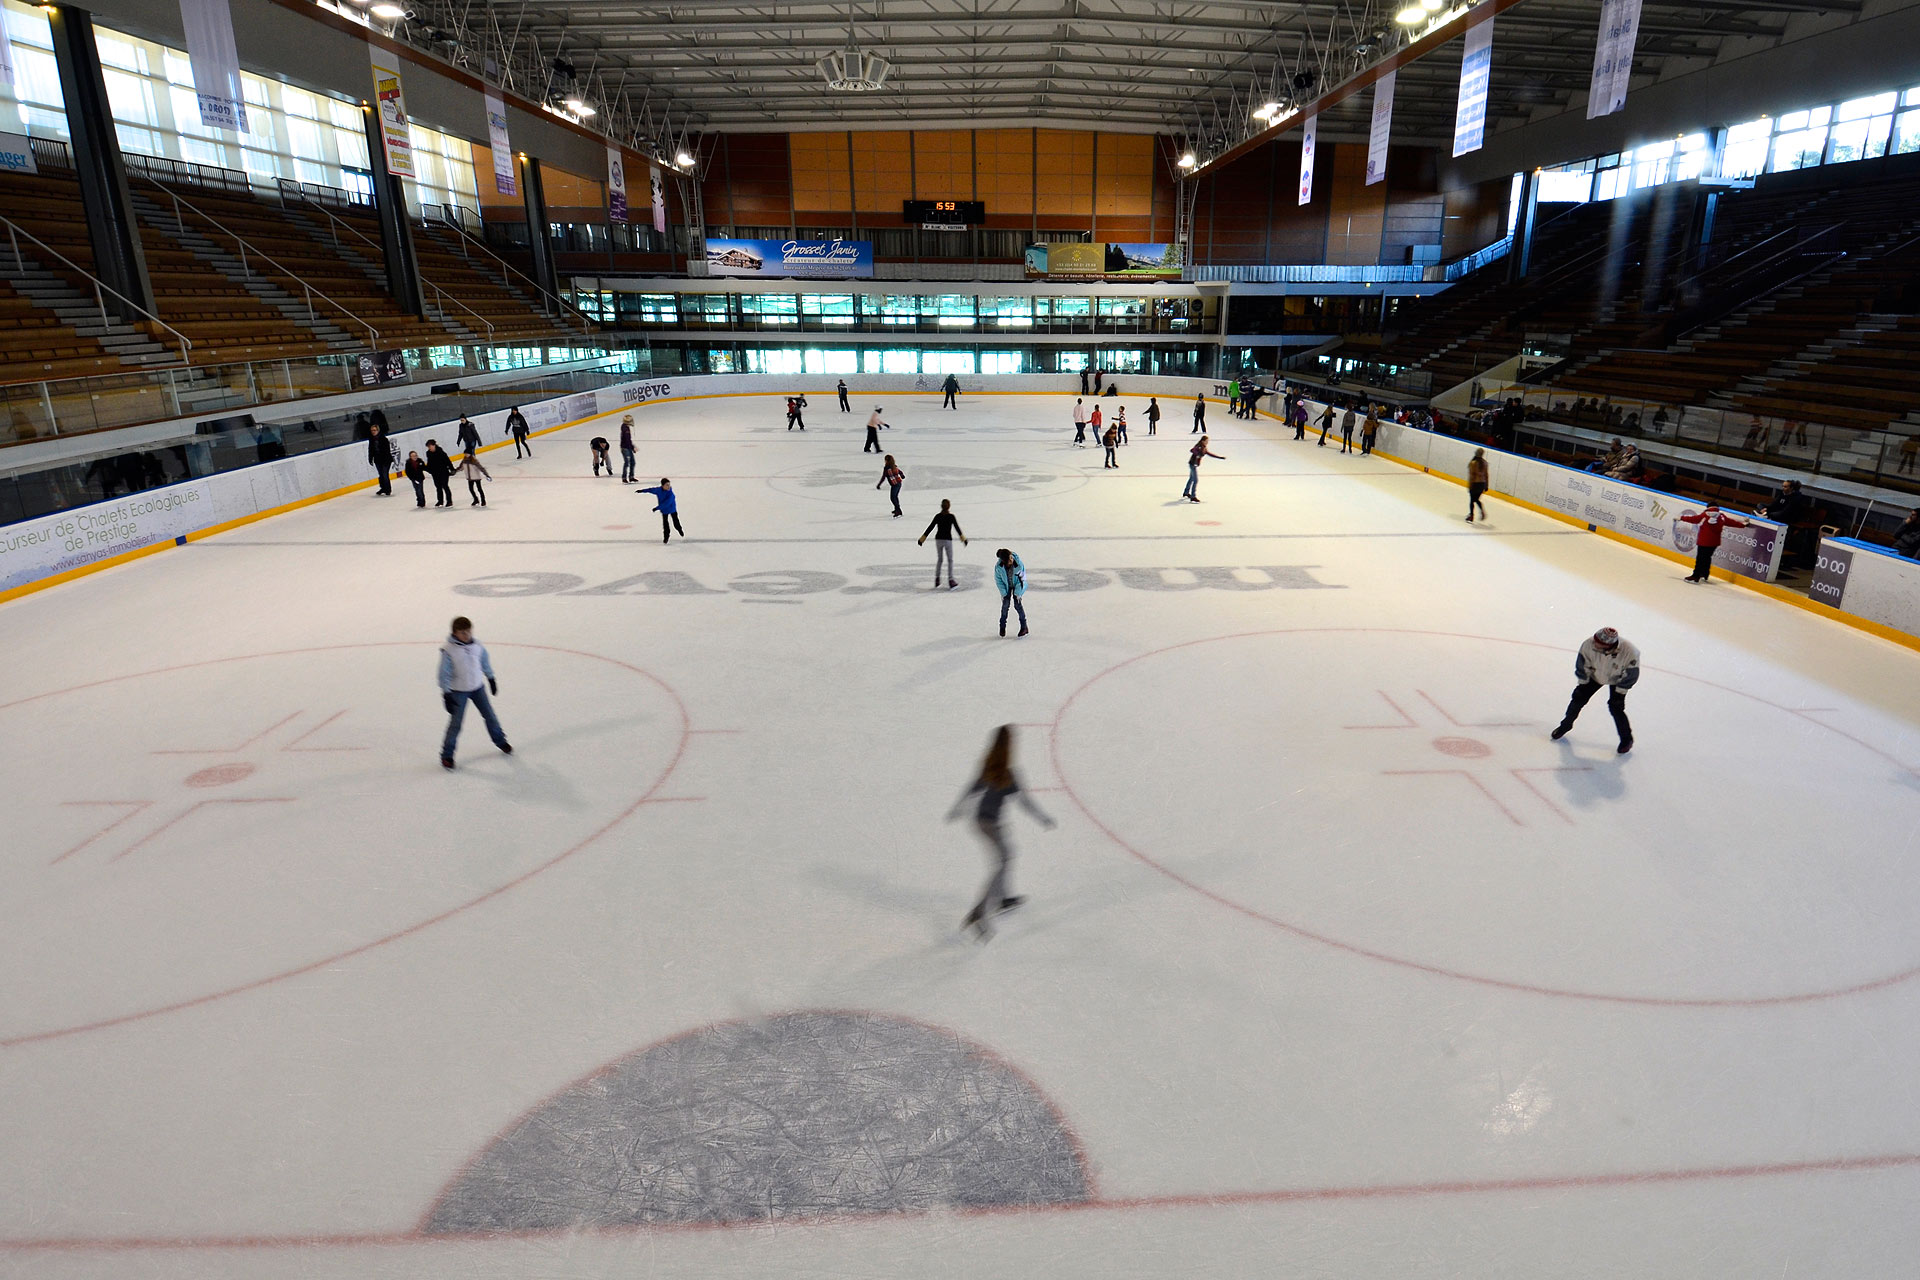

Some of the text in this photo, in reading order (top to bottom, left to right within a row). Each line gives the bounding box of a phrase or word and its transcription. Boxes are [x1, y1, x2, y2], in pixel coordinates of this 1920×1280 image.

[781, 238, 860, 259] Grosset Janin
[623, 382, 671, 402] megève
[55, 522, 74, 538] de
[77, 506, 128, 528] Chalets
[1624, 516, 1666, 540] Restaurant
[65, 521, 137, 552] de Prestige
[1830, 559, 1846, 575] 00
